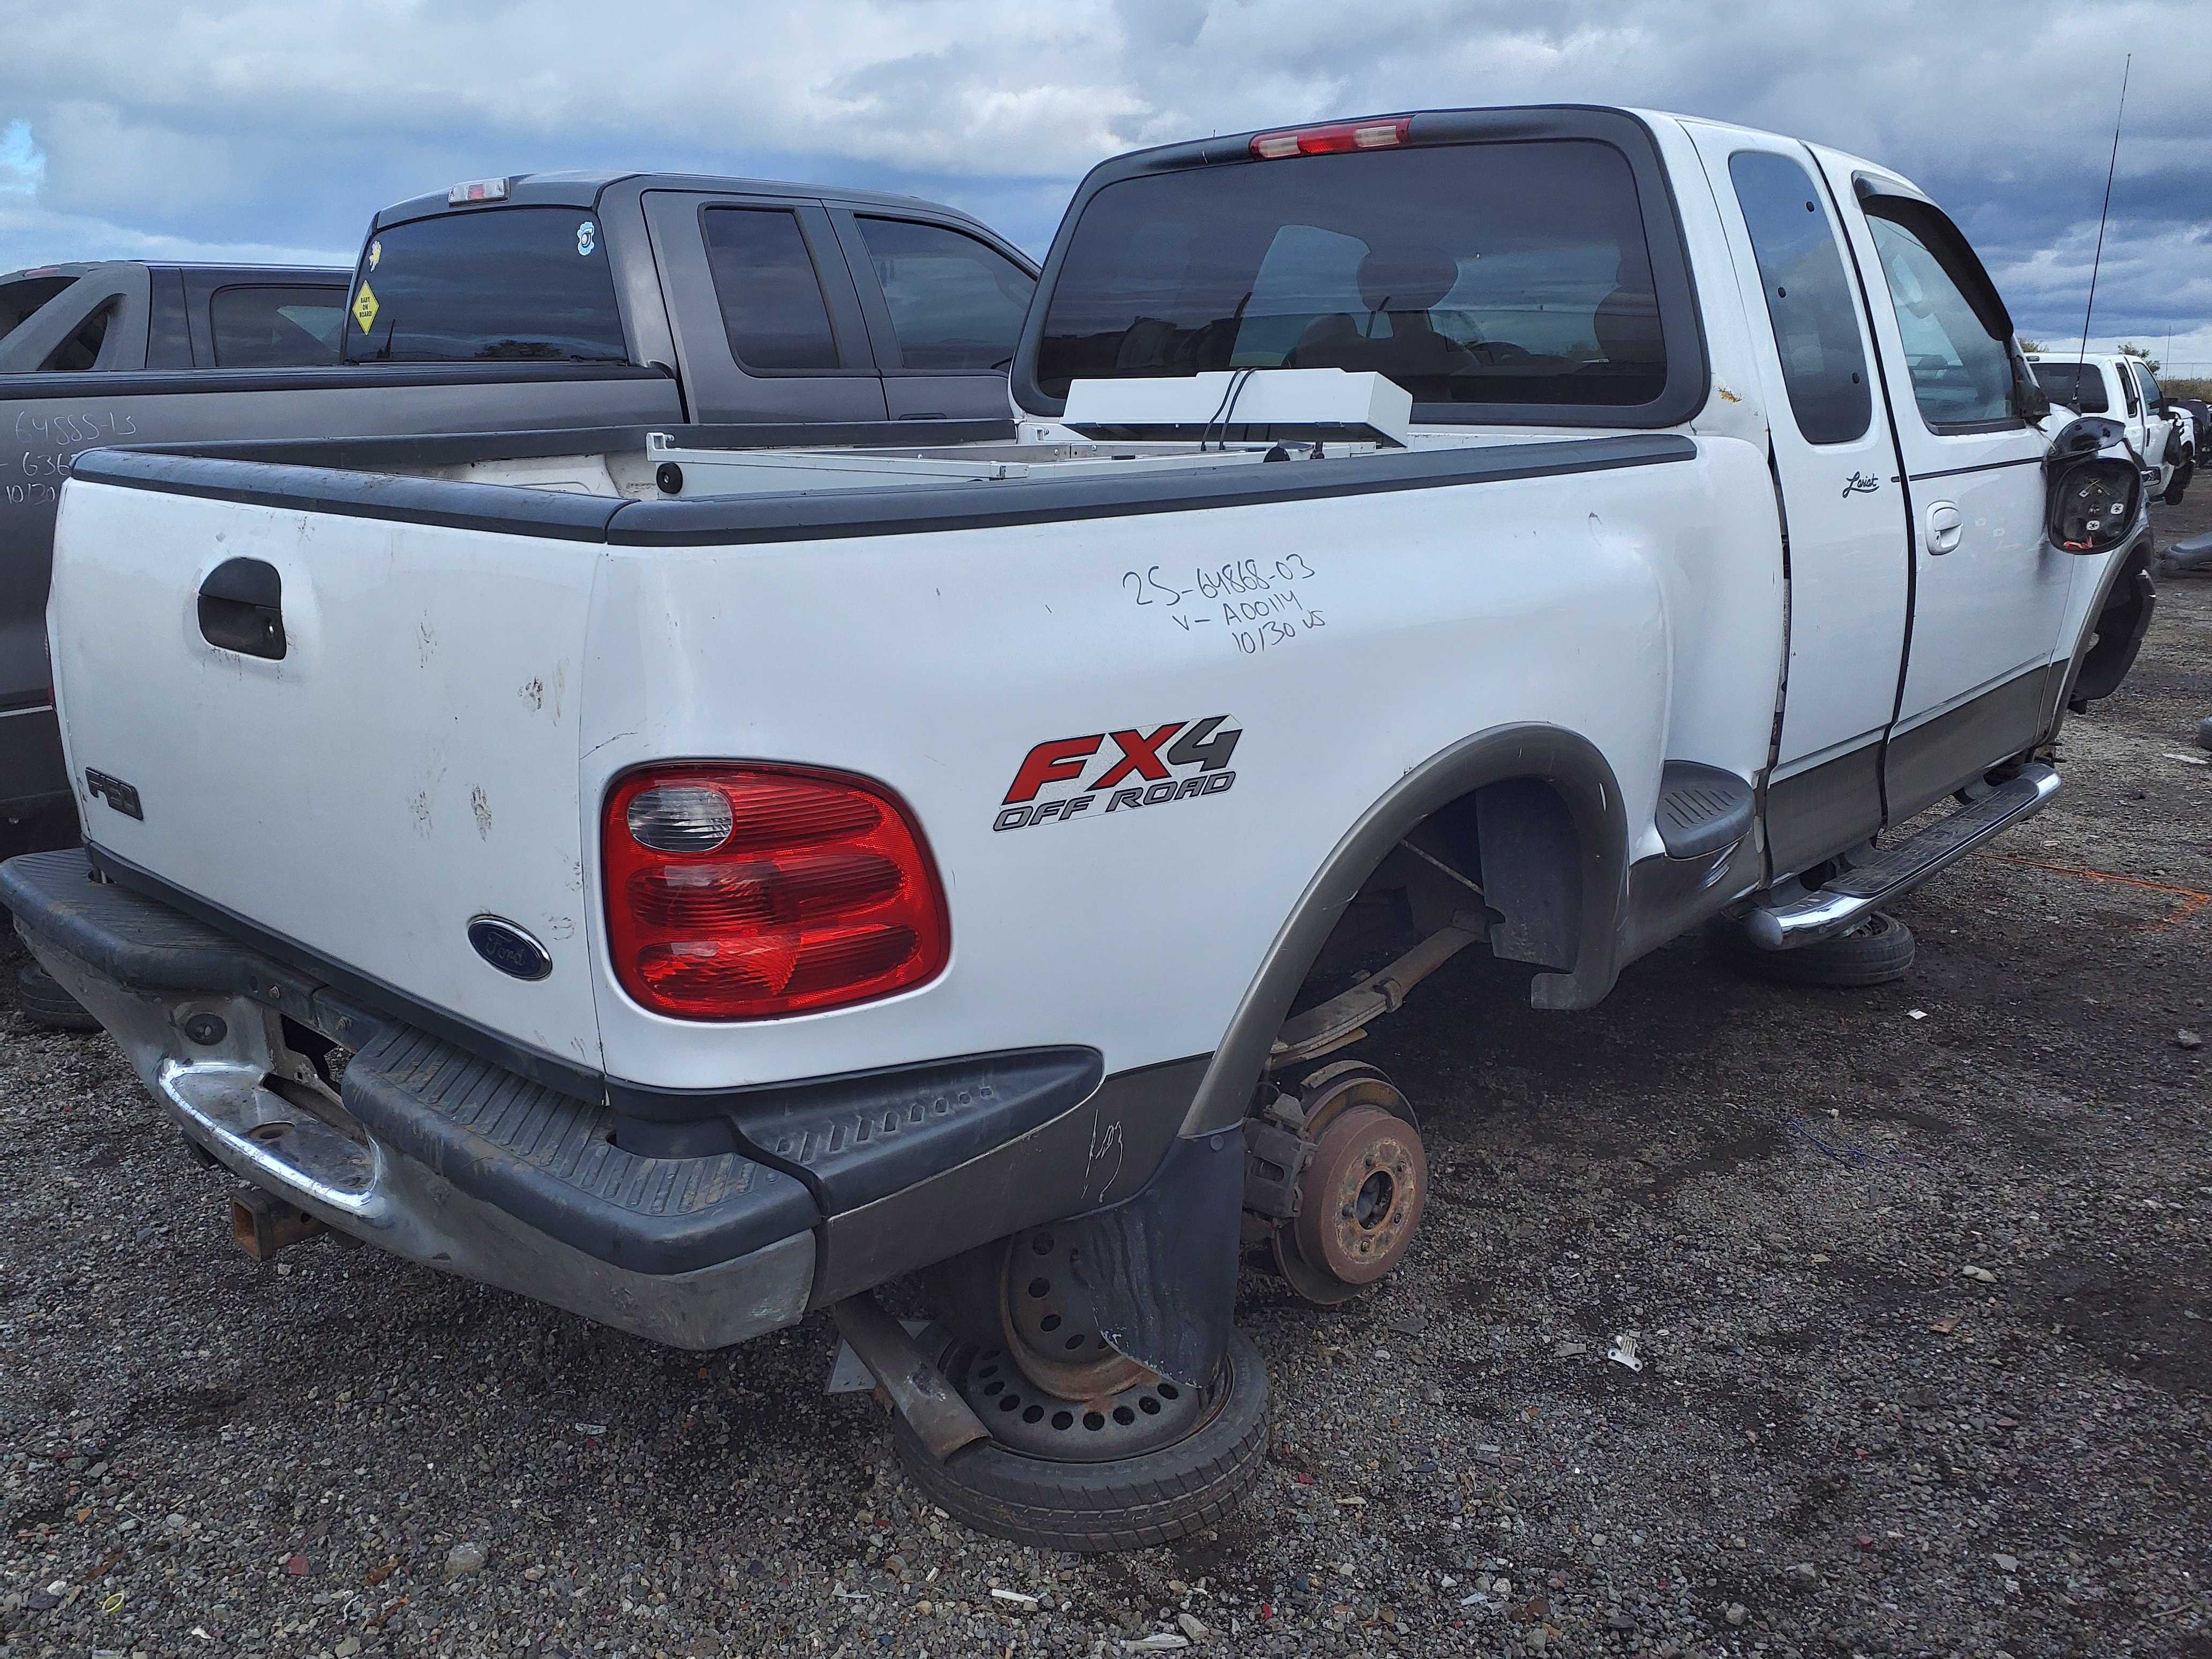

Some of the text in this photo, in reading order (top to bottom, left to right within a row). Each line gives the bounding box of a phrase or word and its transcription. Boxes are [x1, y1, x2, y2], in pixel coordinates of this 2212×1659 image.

[1002, 715, 1243, 805] FX4
[992, 771, 1237, 832] OFF ROAD
[485, 931, 526, 967] Ford
